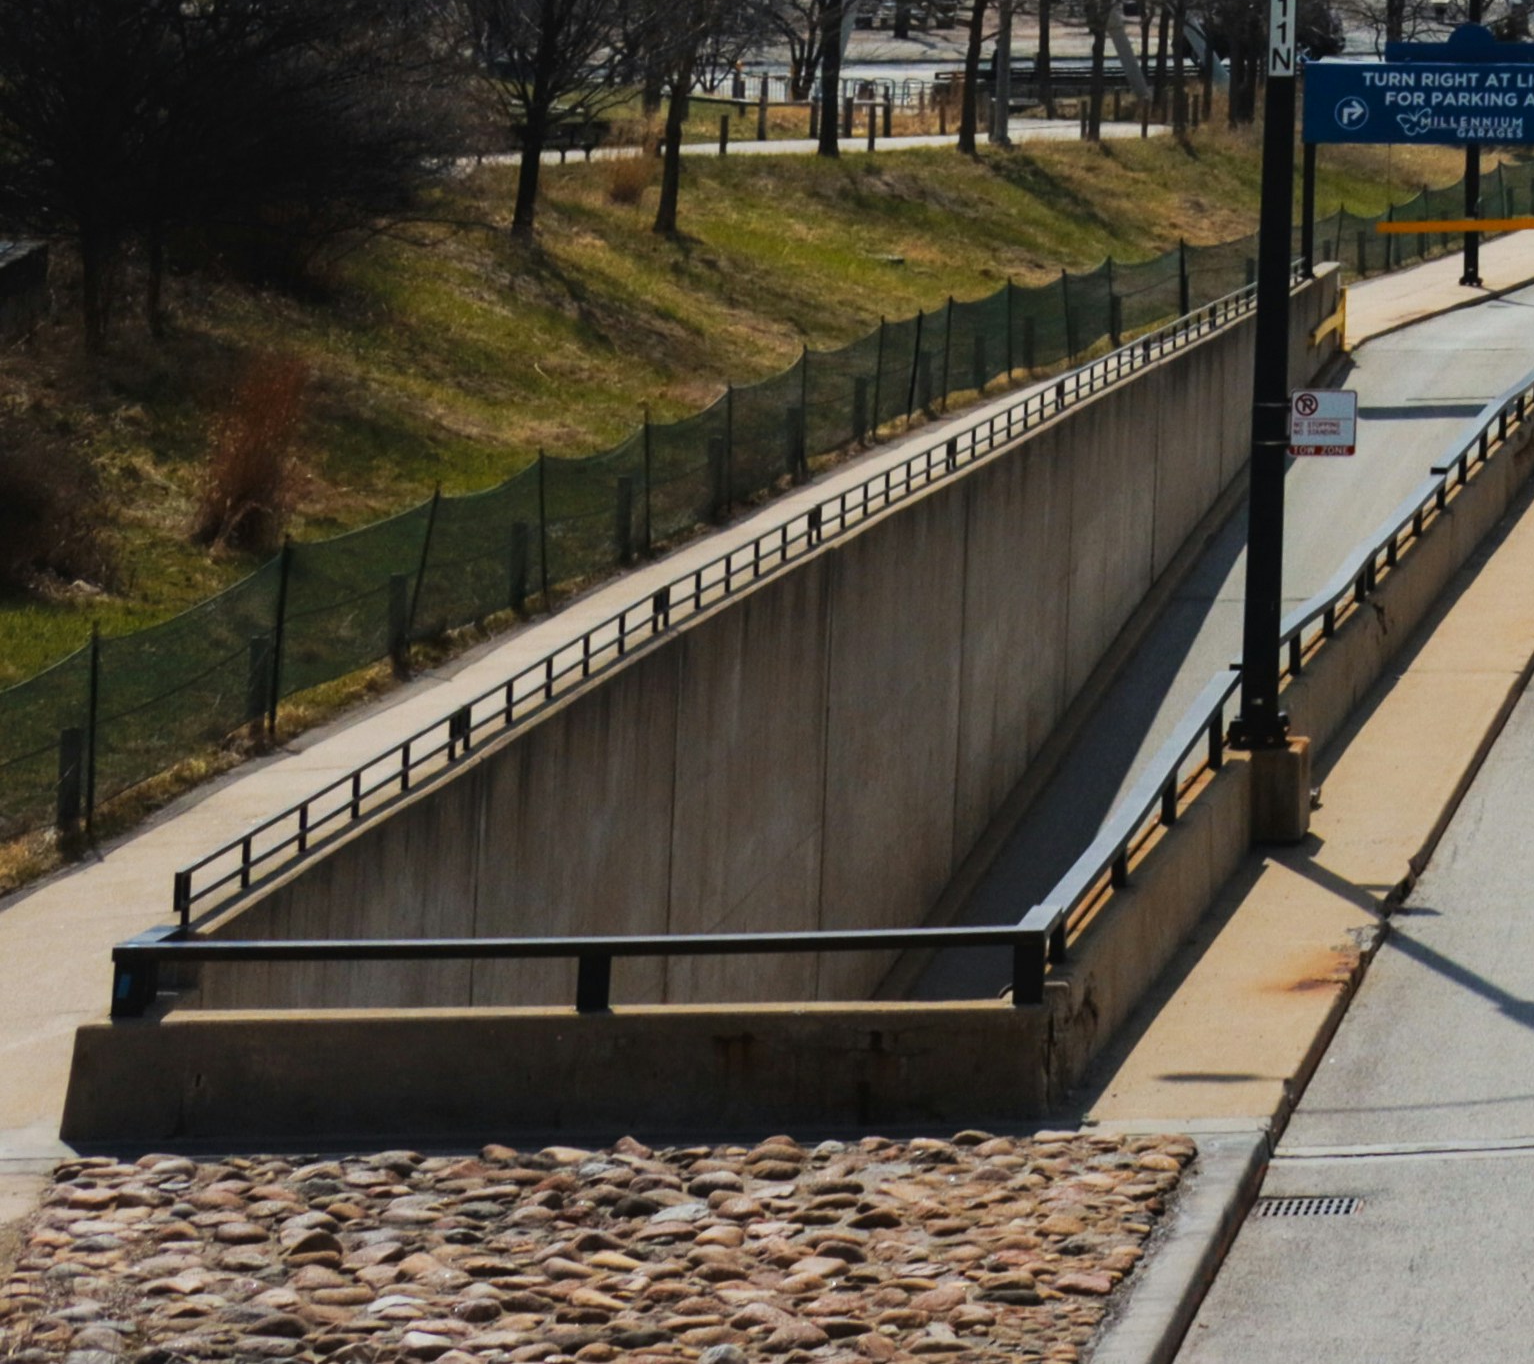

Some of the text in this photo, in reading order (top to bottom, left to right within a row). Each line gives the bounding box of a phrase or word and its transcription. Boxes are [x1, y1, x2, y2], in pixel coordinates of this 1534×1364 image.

[1363, 72, 1414, 87] TURN
[1422, 73, 1480, 88] RIGHT
[1485, 73, 1511, 88] AT
[1385, 92, 1425, 106] FOR
[1432, 92, 1517, 107] PARKING
[1421, 116, 1523, 127] MILLENNIUM
[1457, 128, 1523, 138] GARAGES
[1293, 446, 1349, 455] TOW ZONE
